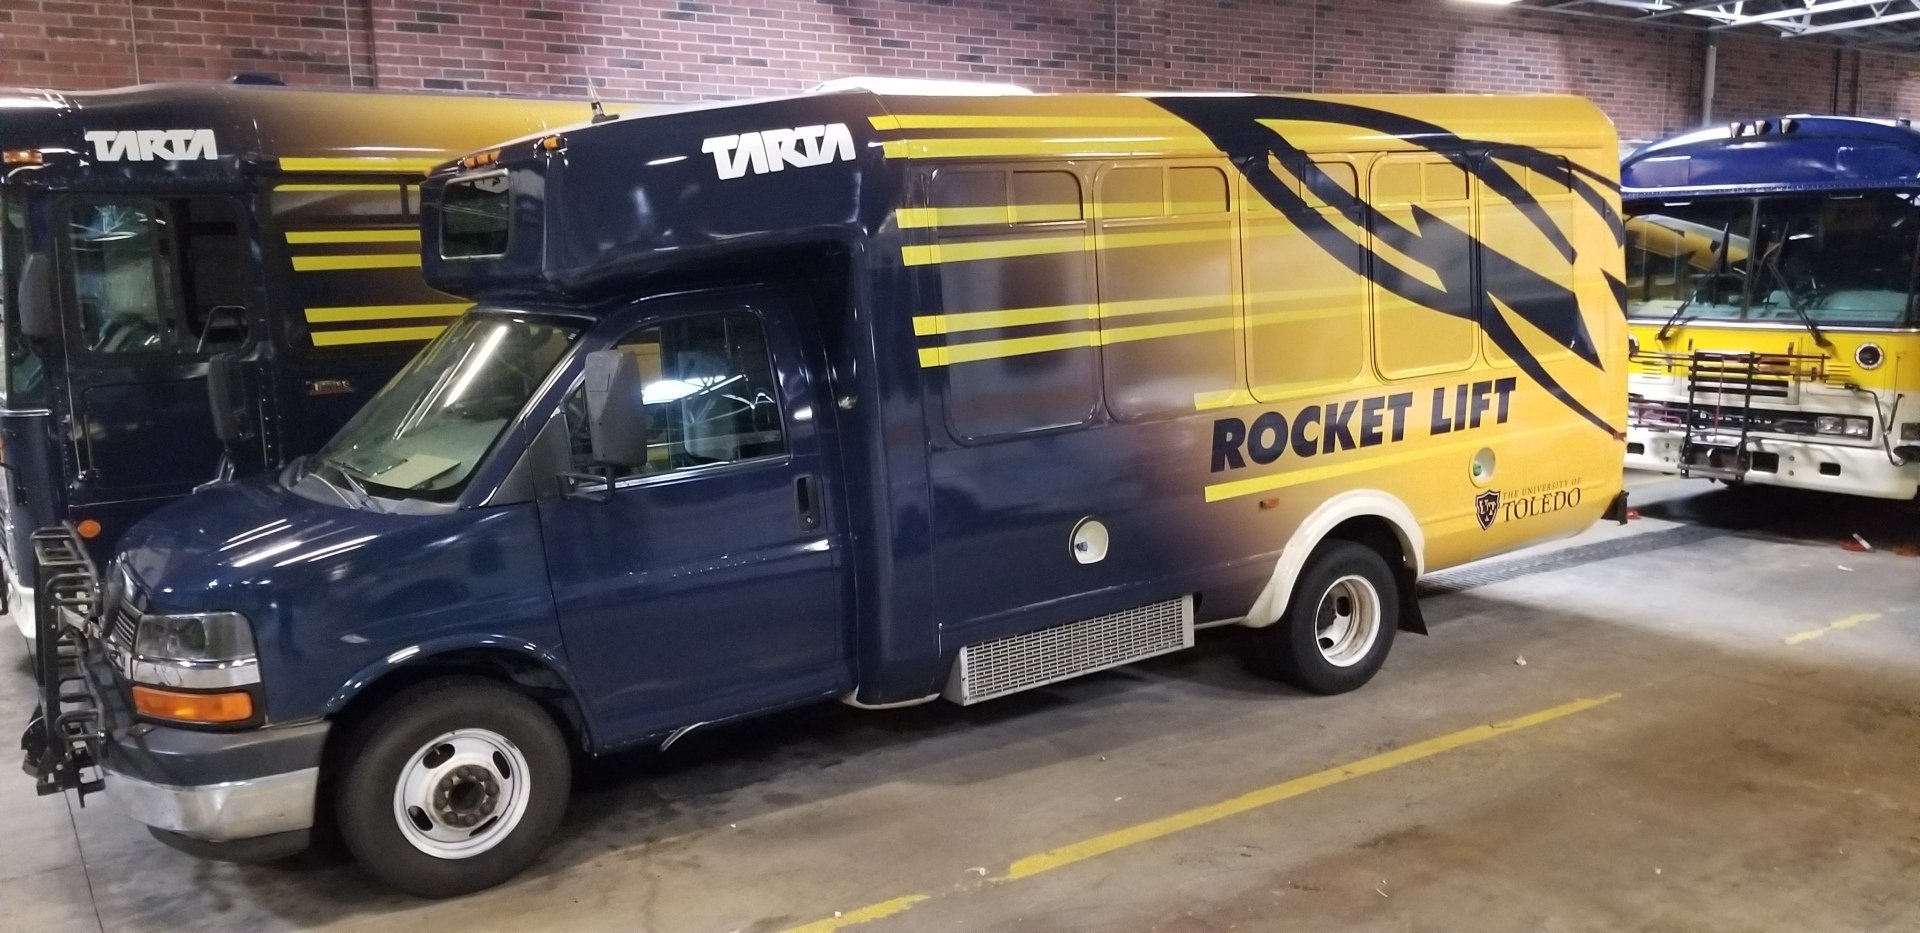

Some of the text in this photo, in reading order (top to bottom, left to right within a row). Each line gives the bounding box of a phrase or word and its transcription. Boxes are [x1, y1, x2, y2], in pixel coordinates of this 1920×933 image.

[85, 129, 218, 161] TARTA
[701, 123, 856, 180] TARTA
[1210, 377, 1516, 473] ROCKET LIFT
[1503, 490, 1518, 500] THE
[1521, 481, 1567, 497] UNIVERSITY
[1503, 487, 1581, 522] TOLEDO
